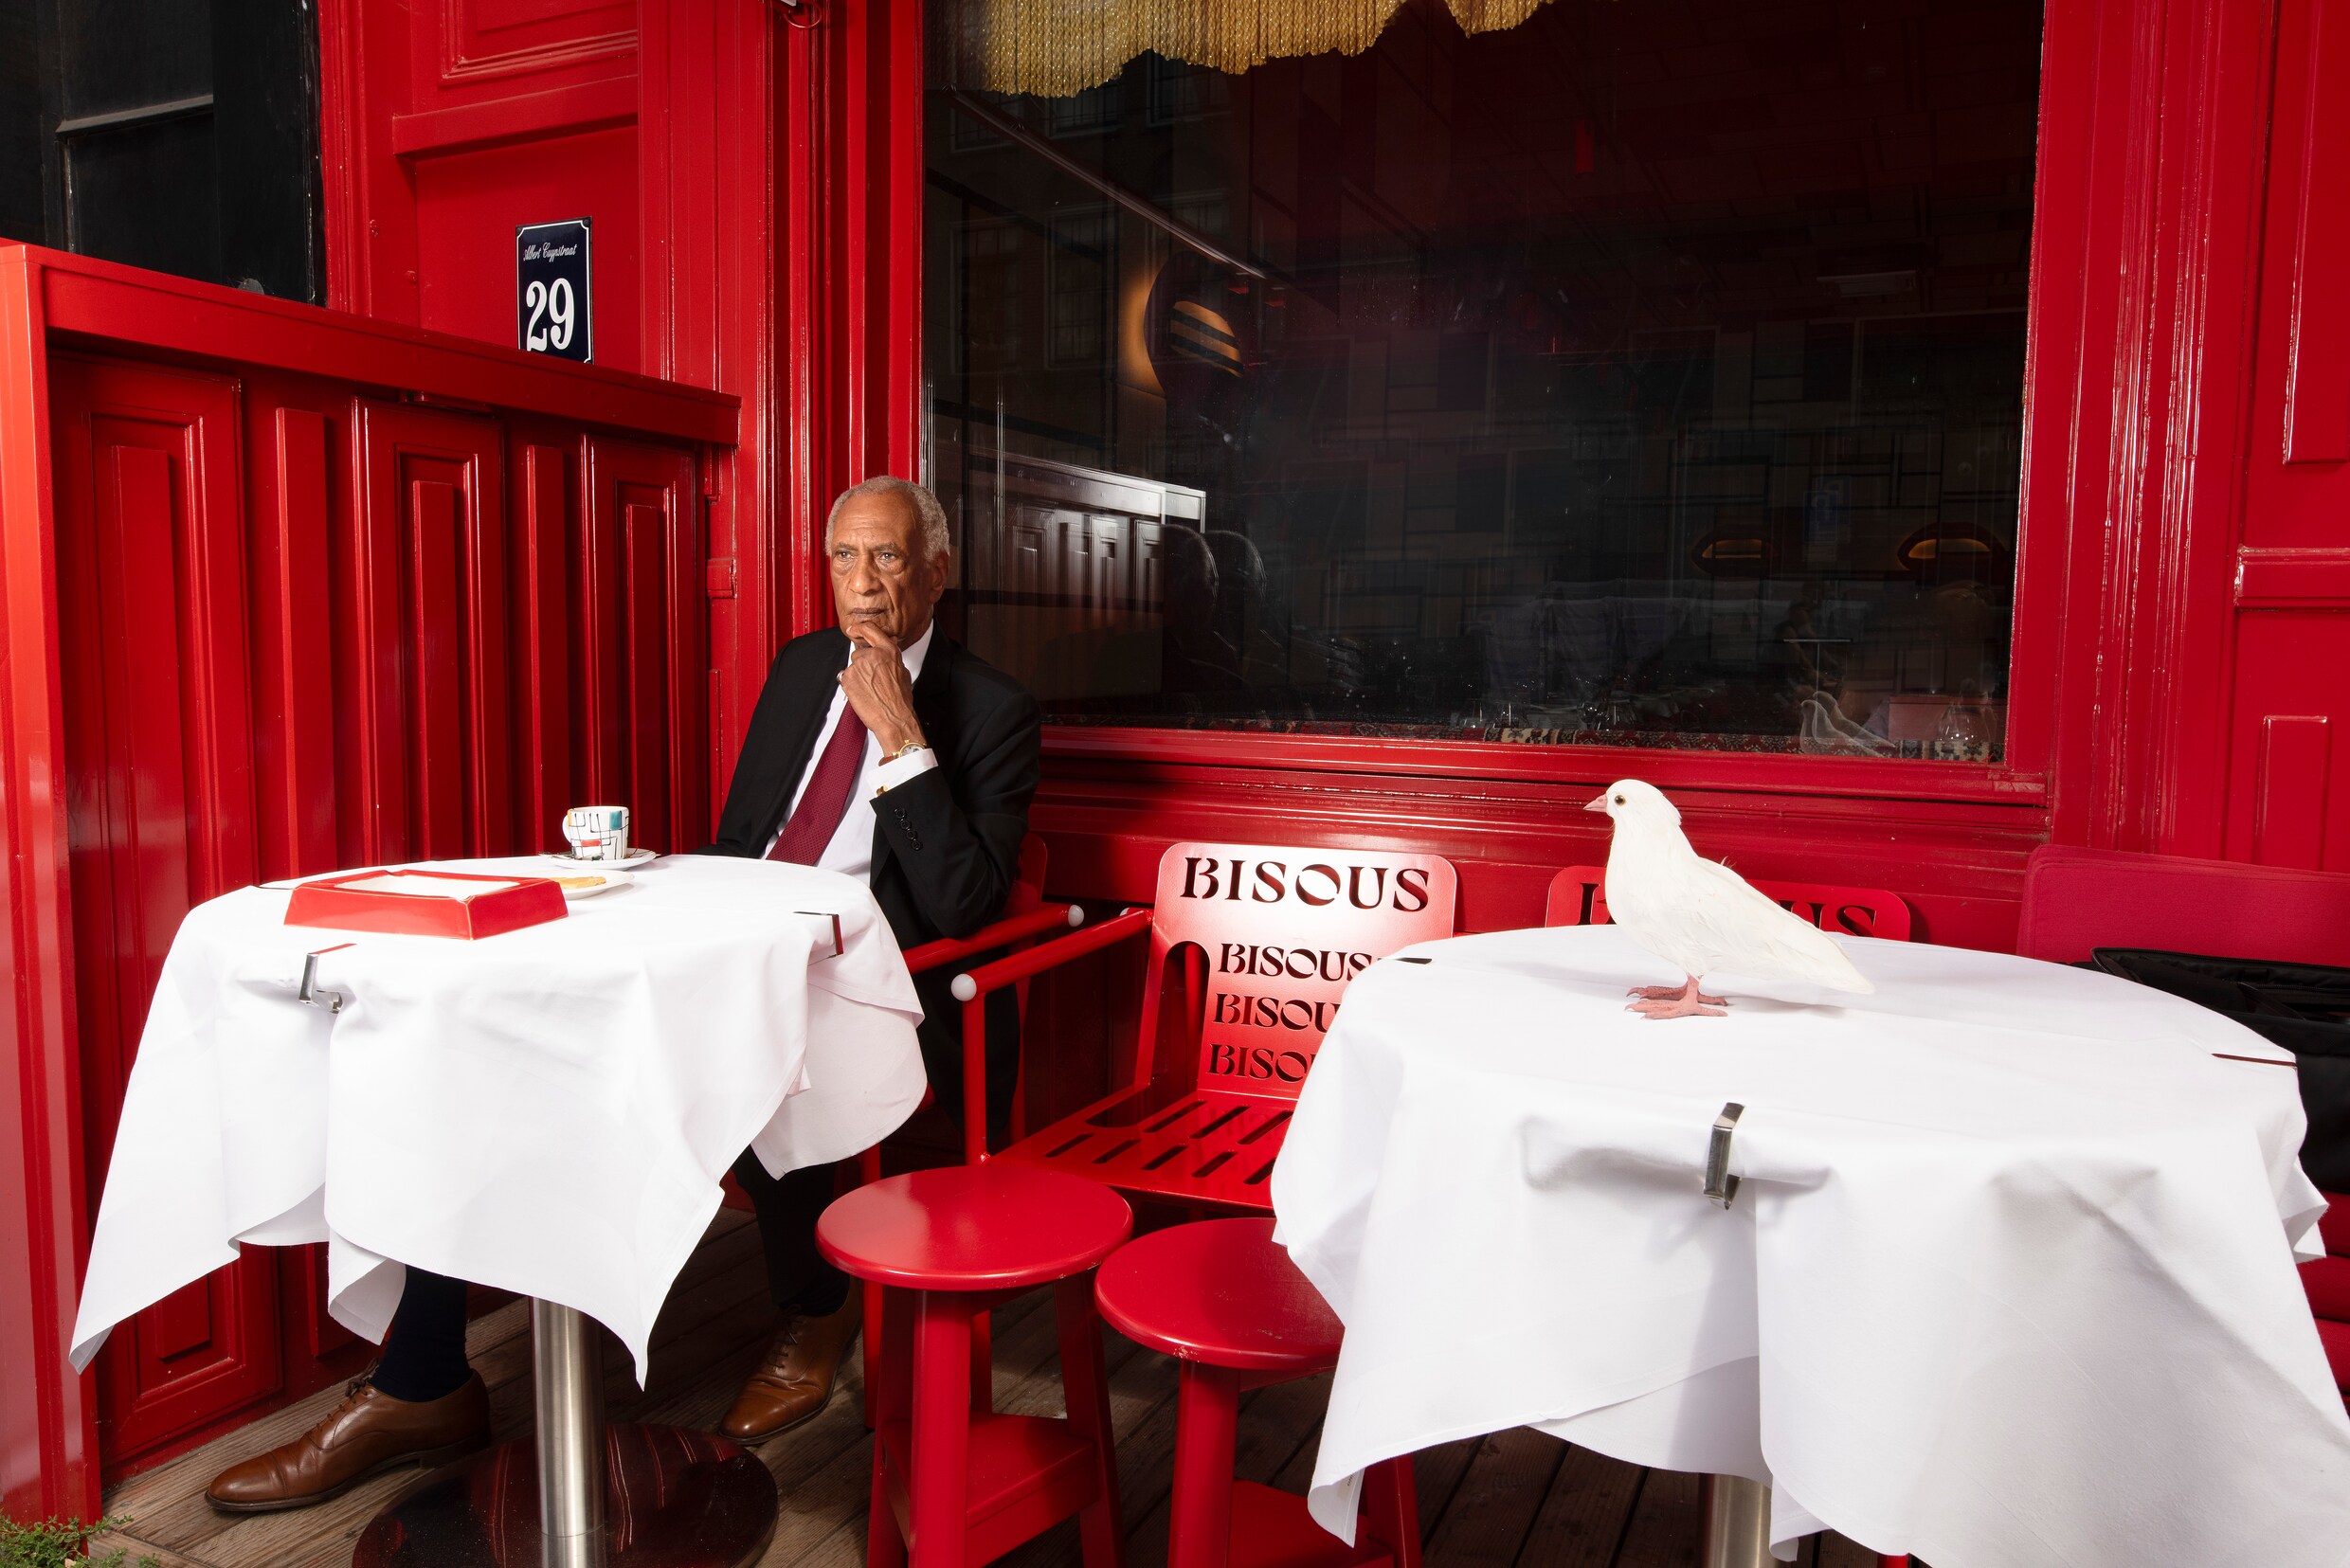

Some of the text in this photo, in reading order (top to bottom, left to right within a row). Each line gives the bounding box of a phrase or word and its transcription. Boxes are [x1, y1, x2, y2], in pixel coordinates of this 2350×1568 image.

[526, 278, 574, 351] 29
[1180, 856, 1430, 912] BISOUS
[1213, 993, 1340, 1034] BISOU
[1207, 1043, 1315, 1083] BISO
